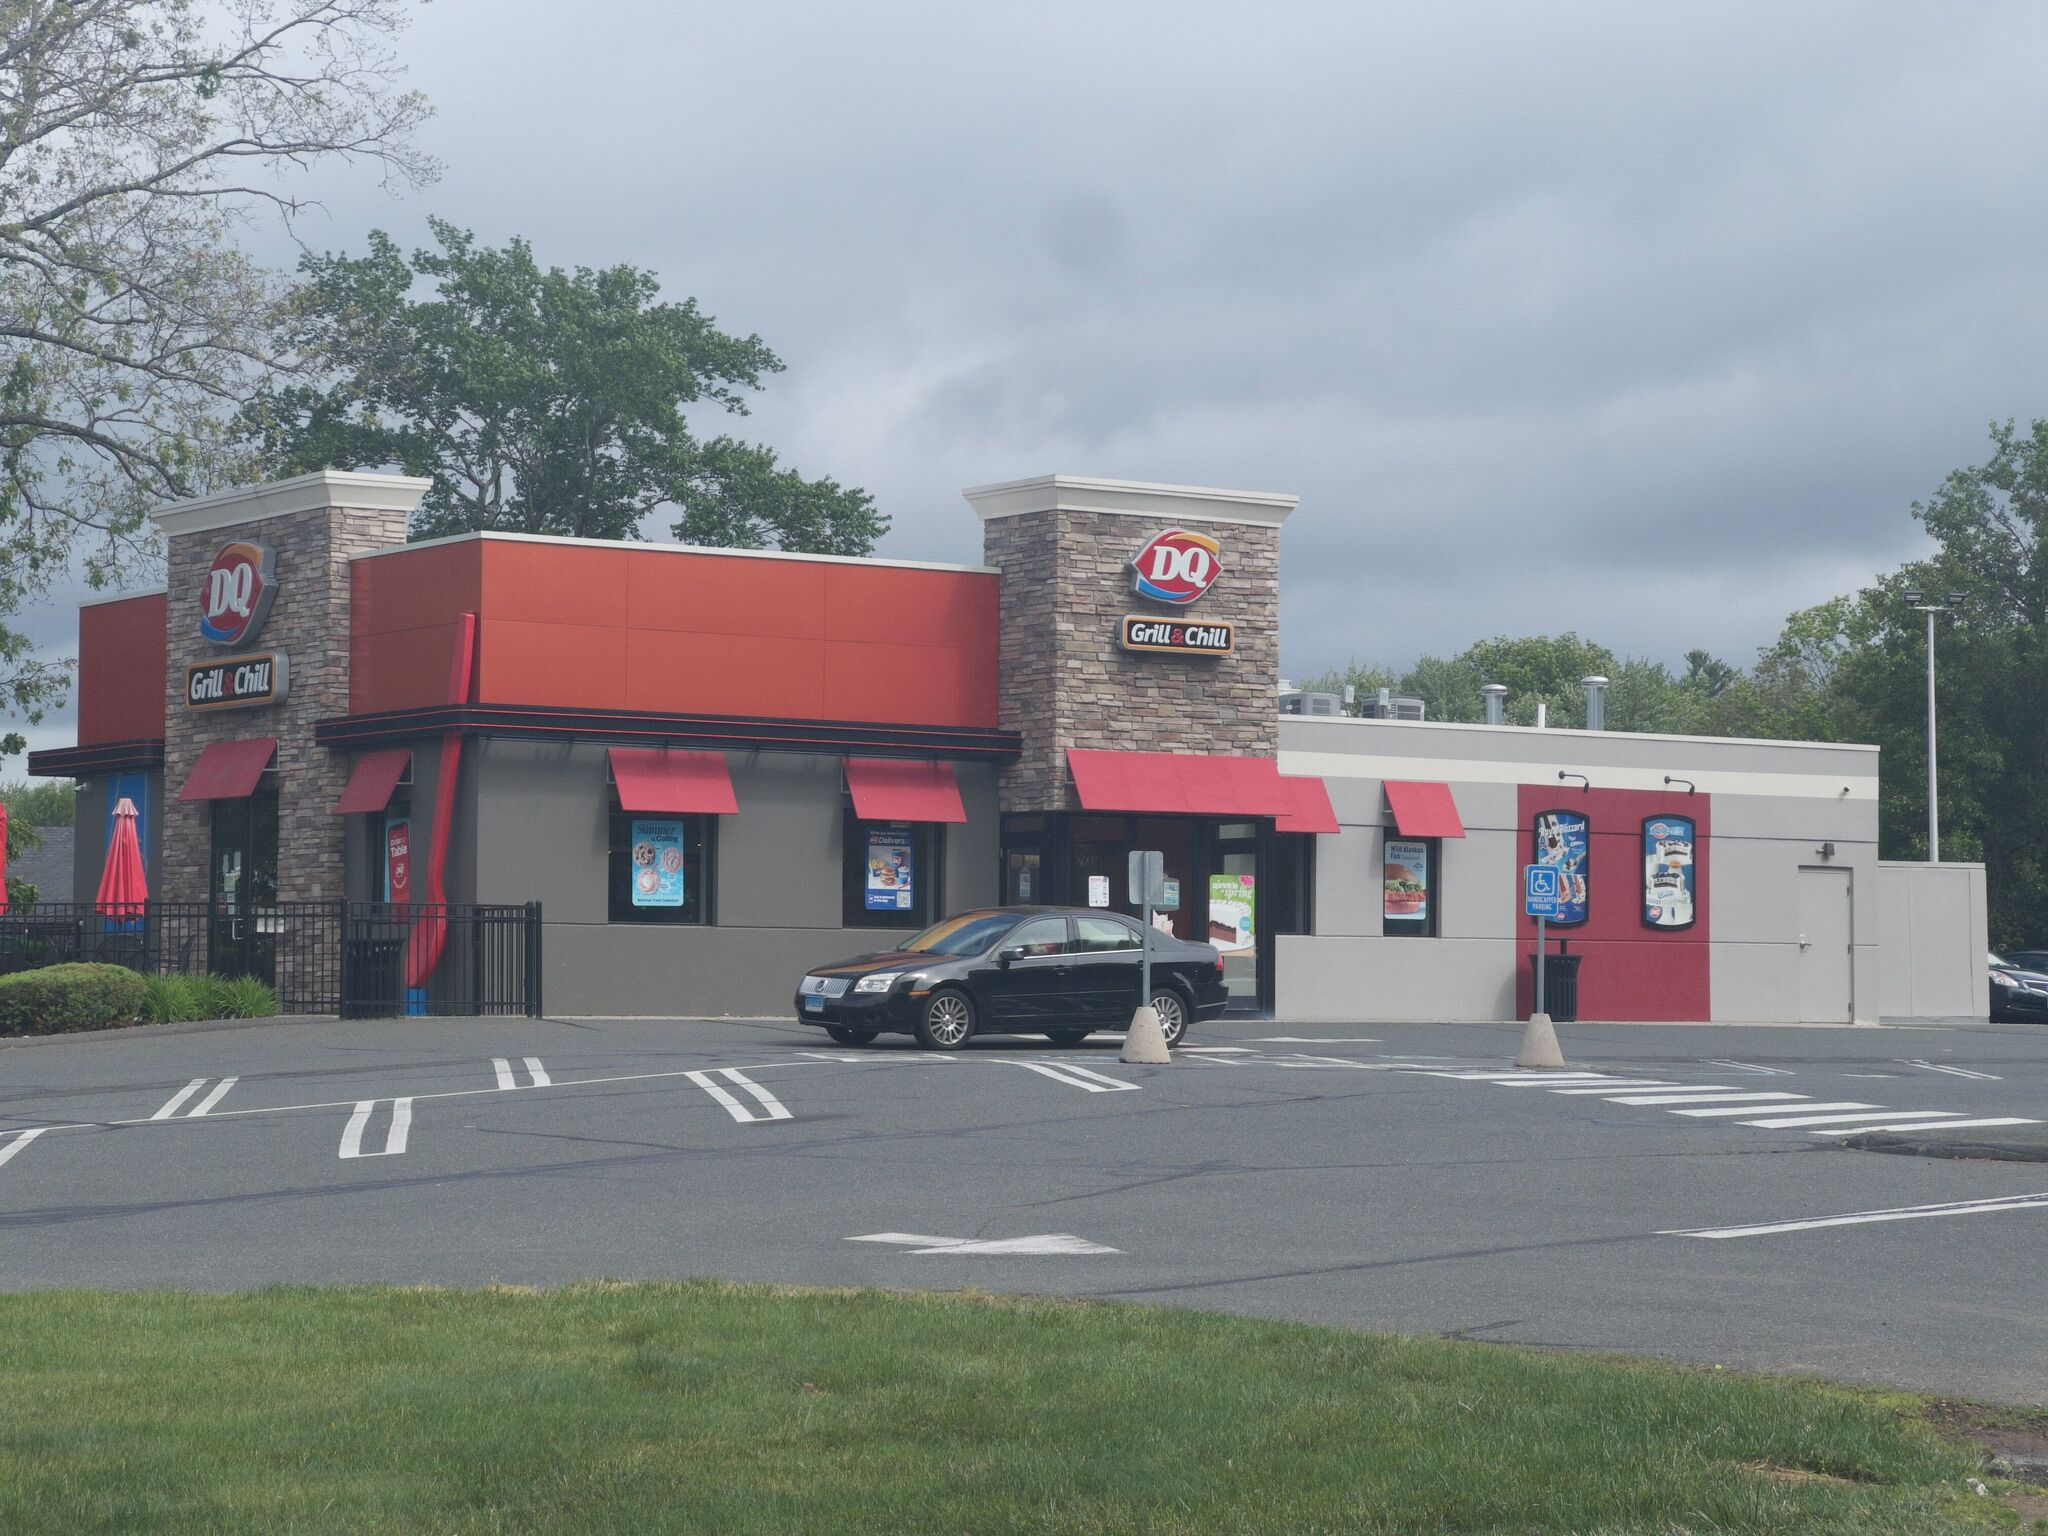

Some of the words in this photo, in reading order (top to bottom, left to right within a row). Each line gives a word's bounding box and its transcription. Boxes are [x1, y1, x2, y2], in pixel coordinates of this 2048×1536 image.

[1150, 546, 1210, 588] DQ
[207, 562, 253, 618] DQ
[1131, 623, 1171, 644] Grill
[1185, 627, 1227, 648] Chill
[190, 668, 224, 701] Grill
[233, 661, 271, 696] Chill
[391, 844, 408, 858] Table
[1212, 879, 1239, 890] sprinkle
[1223, 889, 1253, 900] spring
[1528, 895, 1557, 904] HANDICAPPED
[1532, 903, 1553, 911] PARKING
